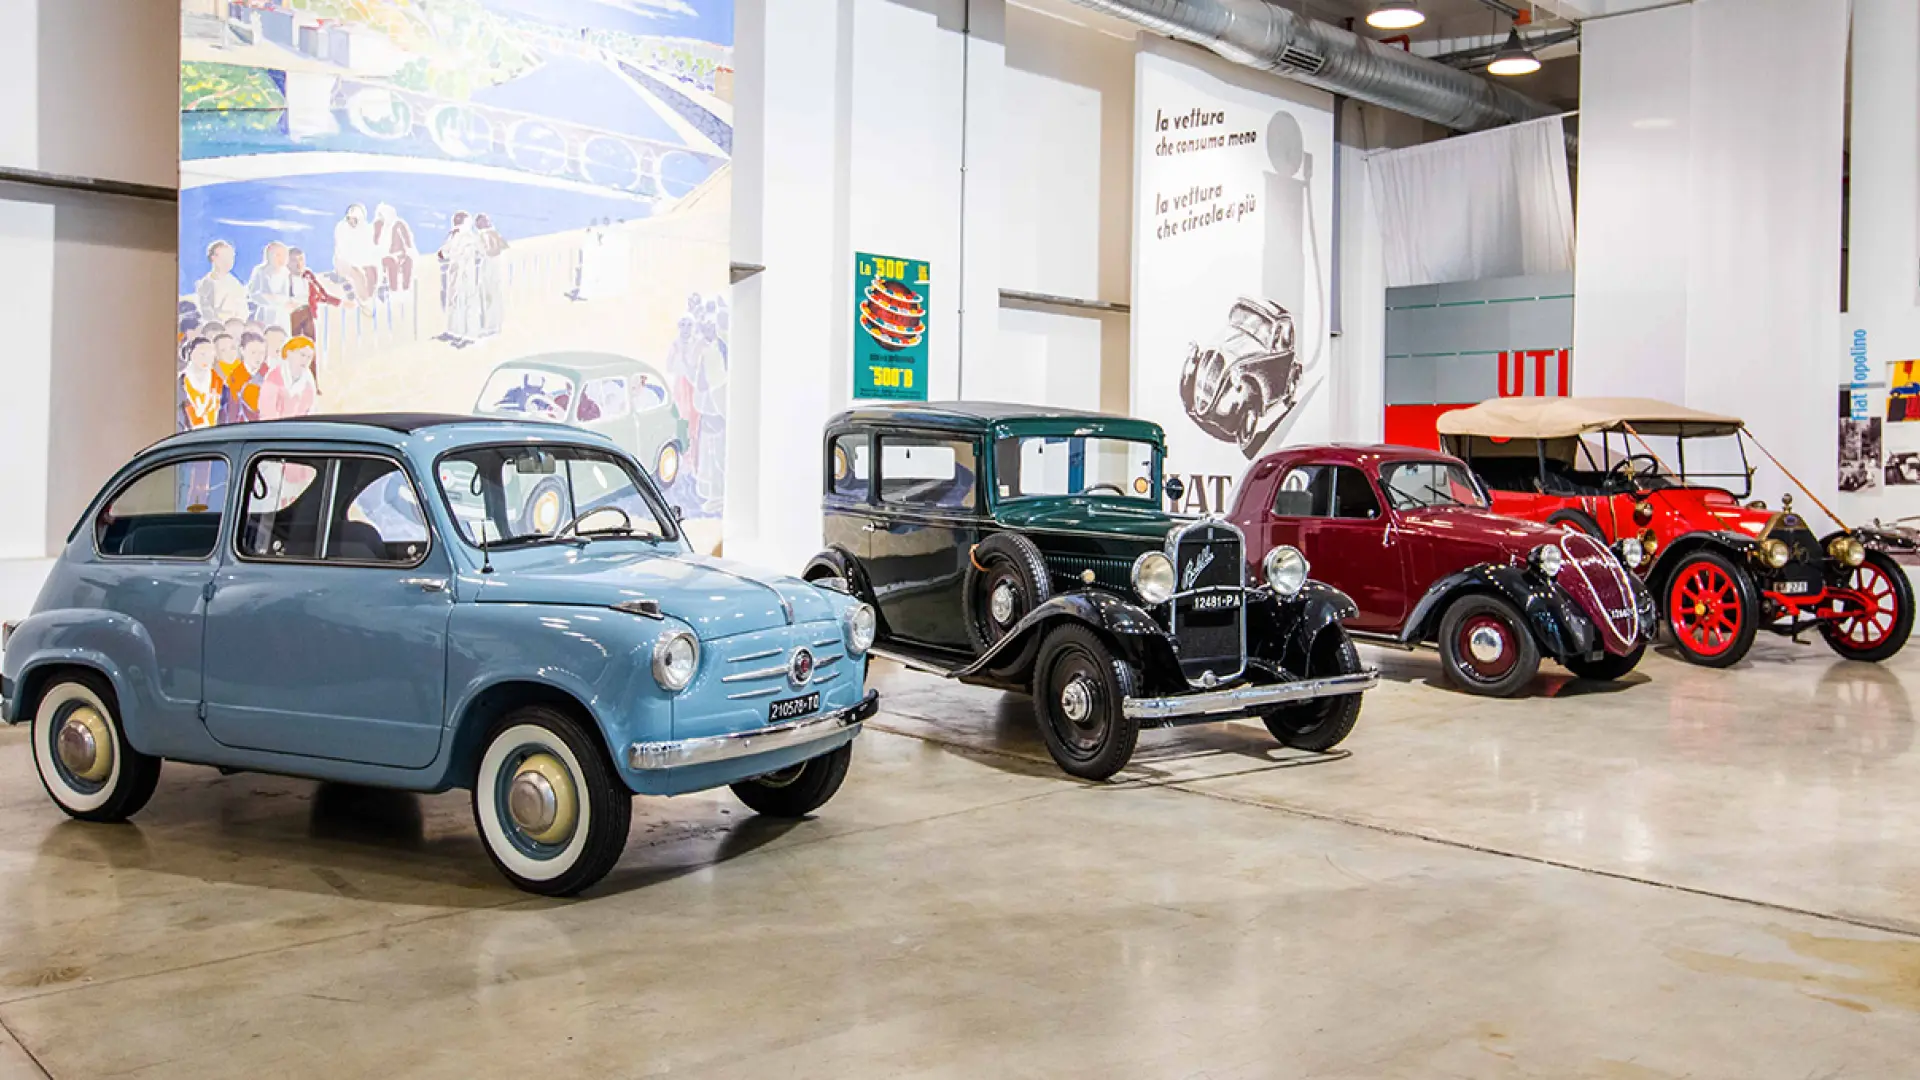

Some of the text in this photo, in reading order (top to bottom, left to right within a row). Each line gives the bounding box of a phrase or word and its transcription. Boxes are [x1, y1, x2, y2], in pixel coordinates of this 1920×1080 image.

[1155, 108, 1225, 132] la vettura
[1155, 129, 1257, 156] che consuma meno
[1155, 184, 1223, 215] la vettura
[1156, 219, 1178, 240] che
[1182, 203, 1224, 233] circola
[1237, 194, 1257, 222] più
[860, 260, 871, 275] La
[1850, 328, 1871, 421] Fiat Topolino
